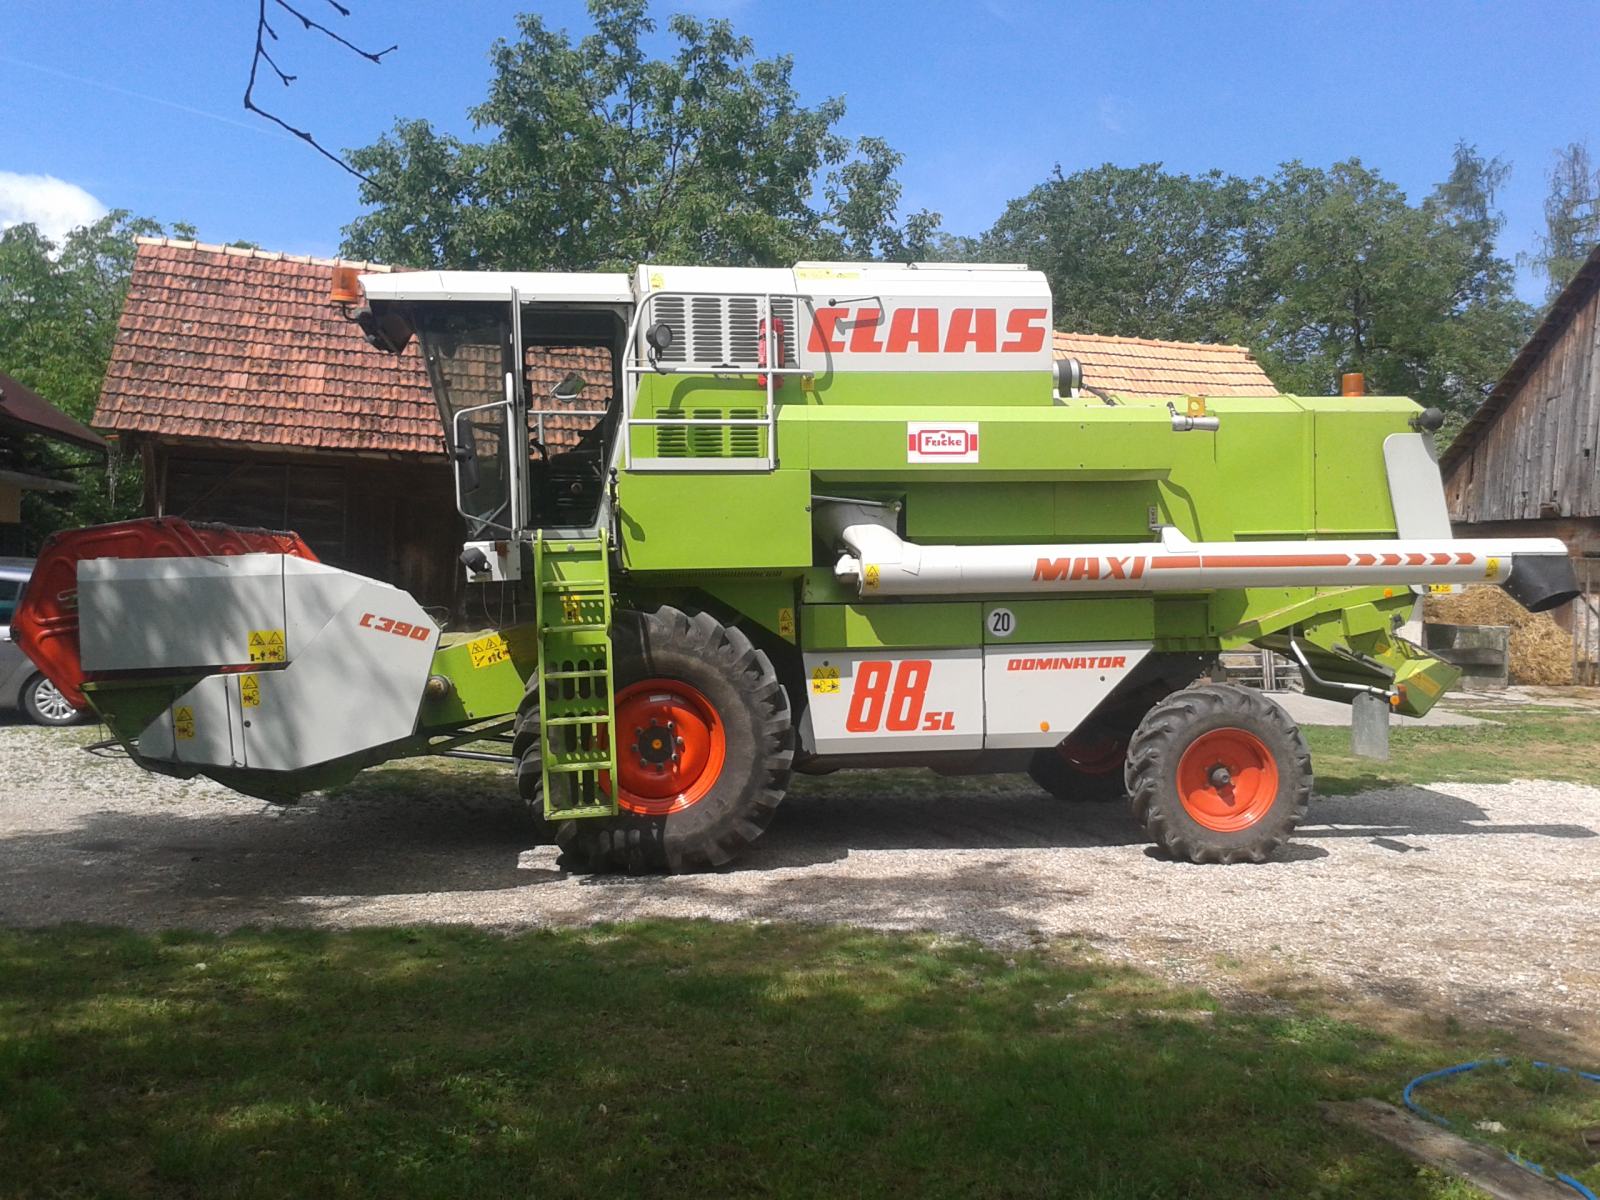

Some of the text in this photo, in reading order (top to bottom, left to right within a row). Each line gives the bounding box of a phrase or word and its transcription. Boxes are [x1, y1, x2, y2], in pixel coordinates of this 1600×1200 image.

[807, 307, 1048, 354] CLAAS
[925, 433, 962, 447] Fricke
[1034, 556, 1146, 582] MAXI
[993, 613, 1010, 632] 20
[1007, 655, 1126, 671] DOMINATOR
[845, 660, 956, 733] 88 SL
